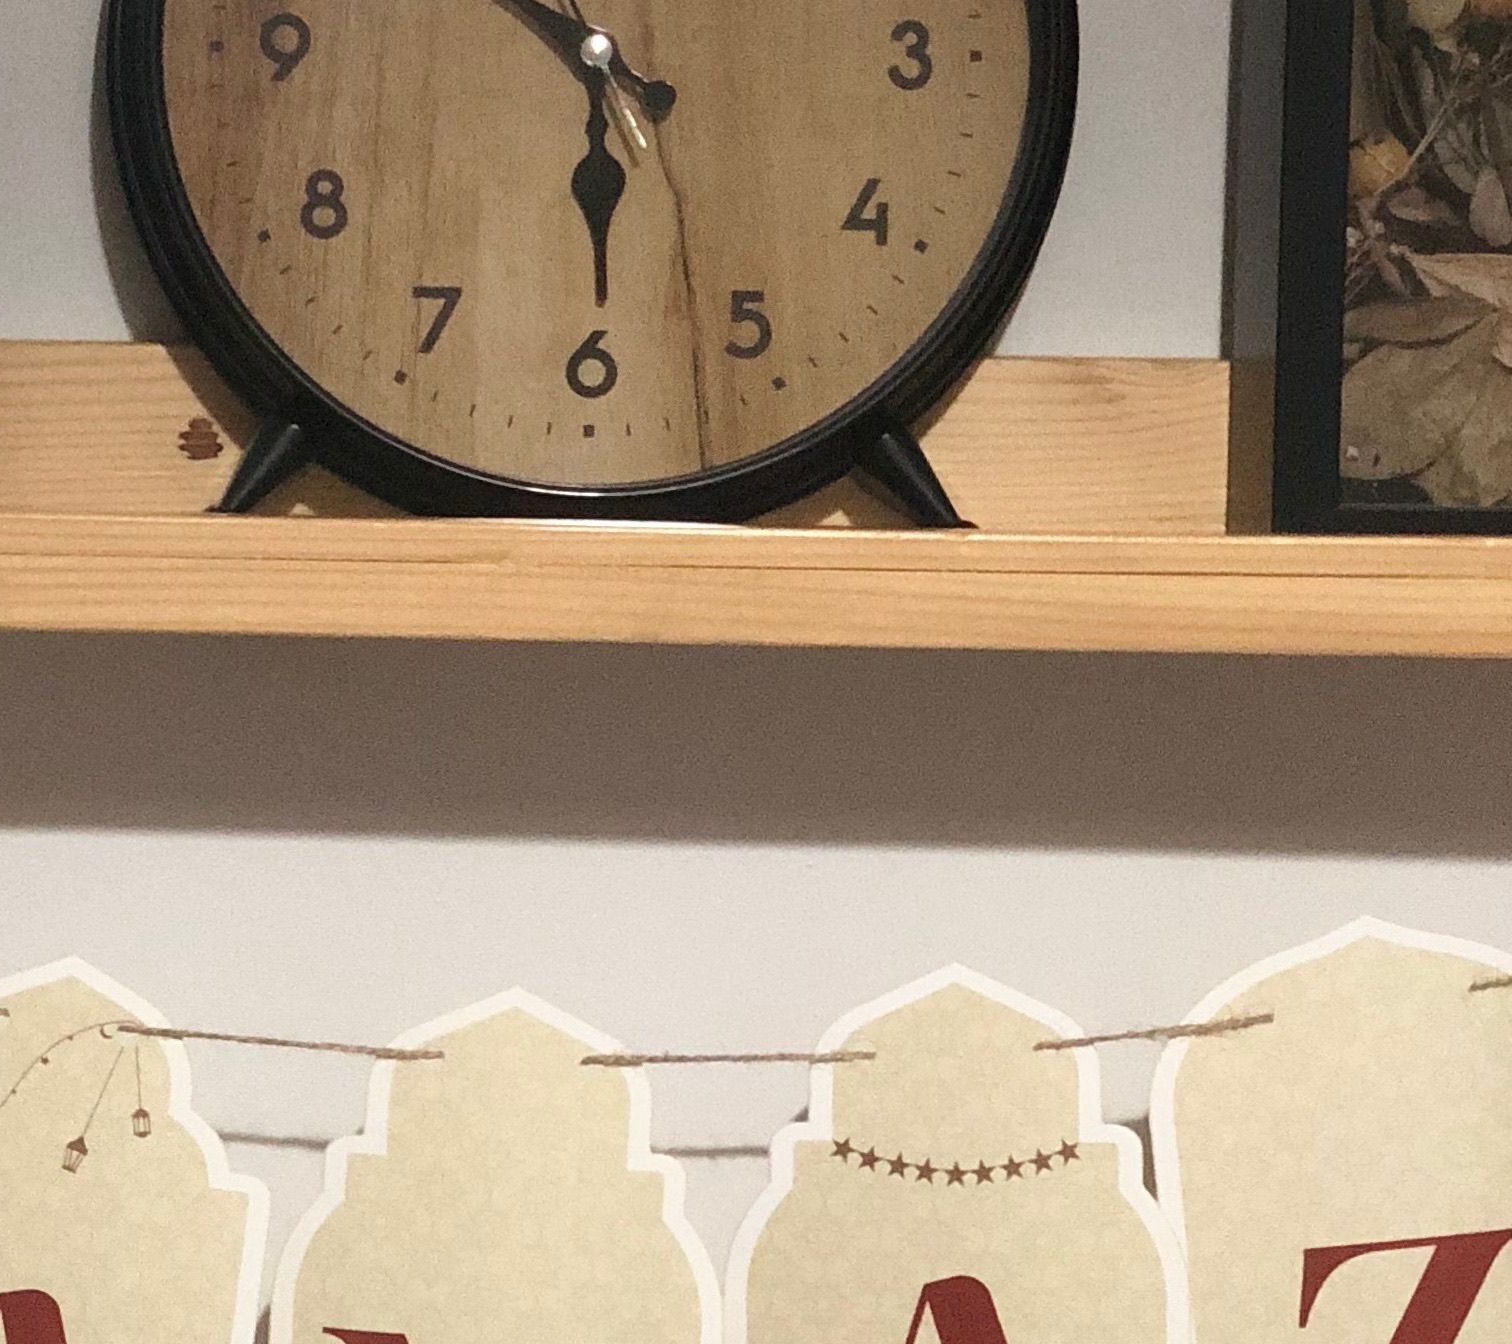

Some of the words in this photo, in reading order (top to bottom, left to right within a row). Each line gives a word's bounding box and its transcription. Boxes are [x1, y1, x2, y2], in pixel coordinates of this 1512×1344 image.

[258, 12, 312, 83] 9
[887, 19, 934, 91] 3
[300, 169, 348, 240] 8
[840, 177, 890, 247] 4
[412, 286, 463, 354] 7
[724, 290, 773, 360] 5
[565, 330, 618, 399] 6
